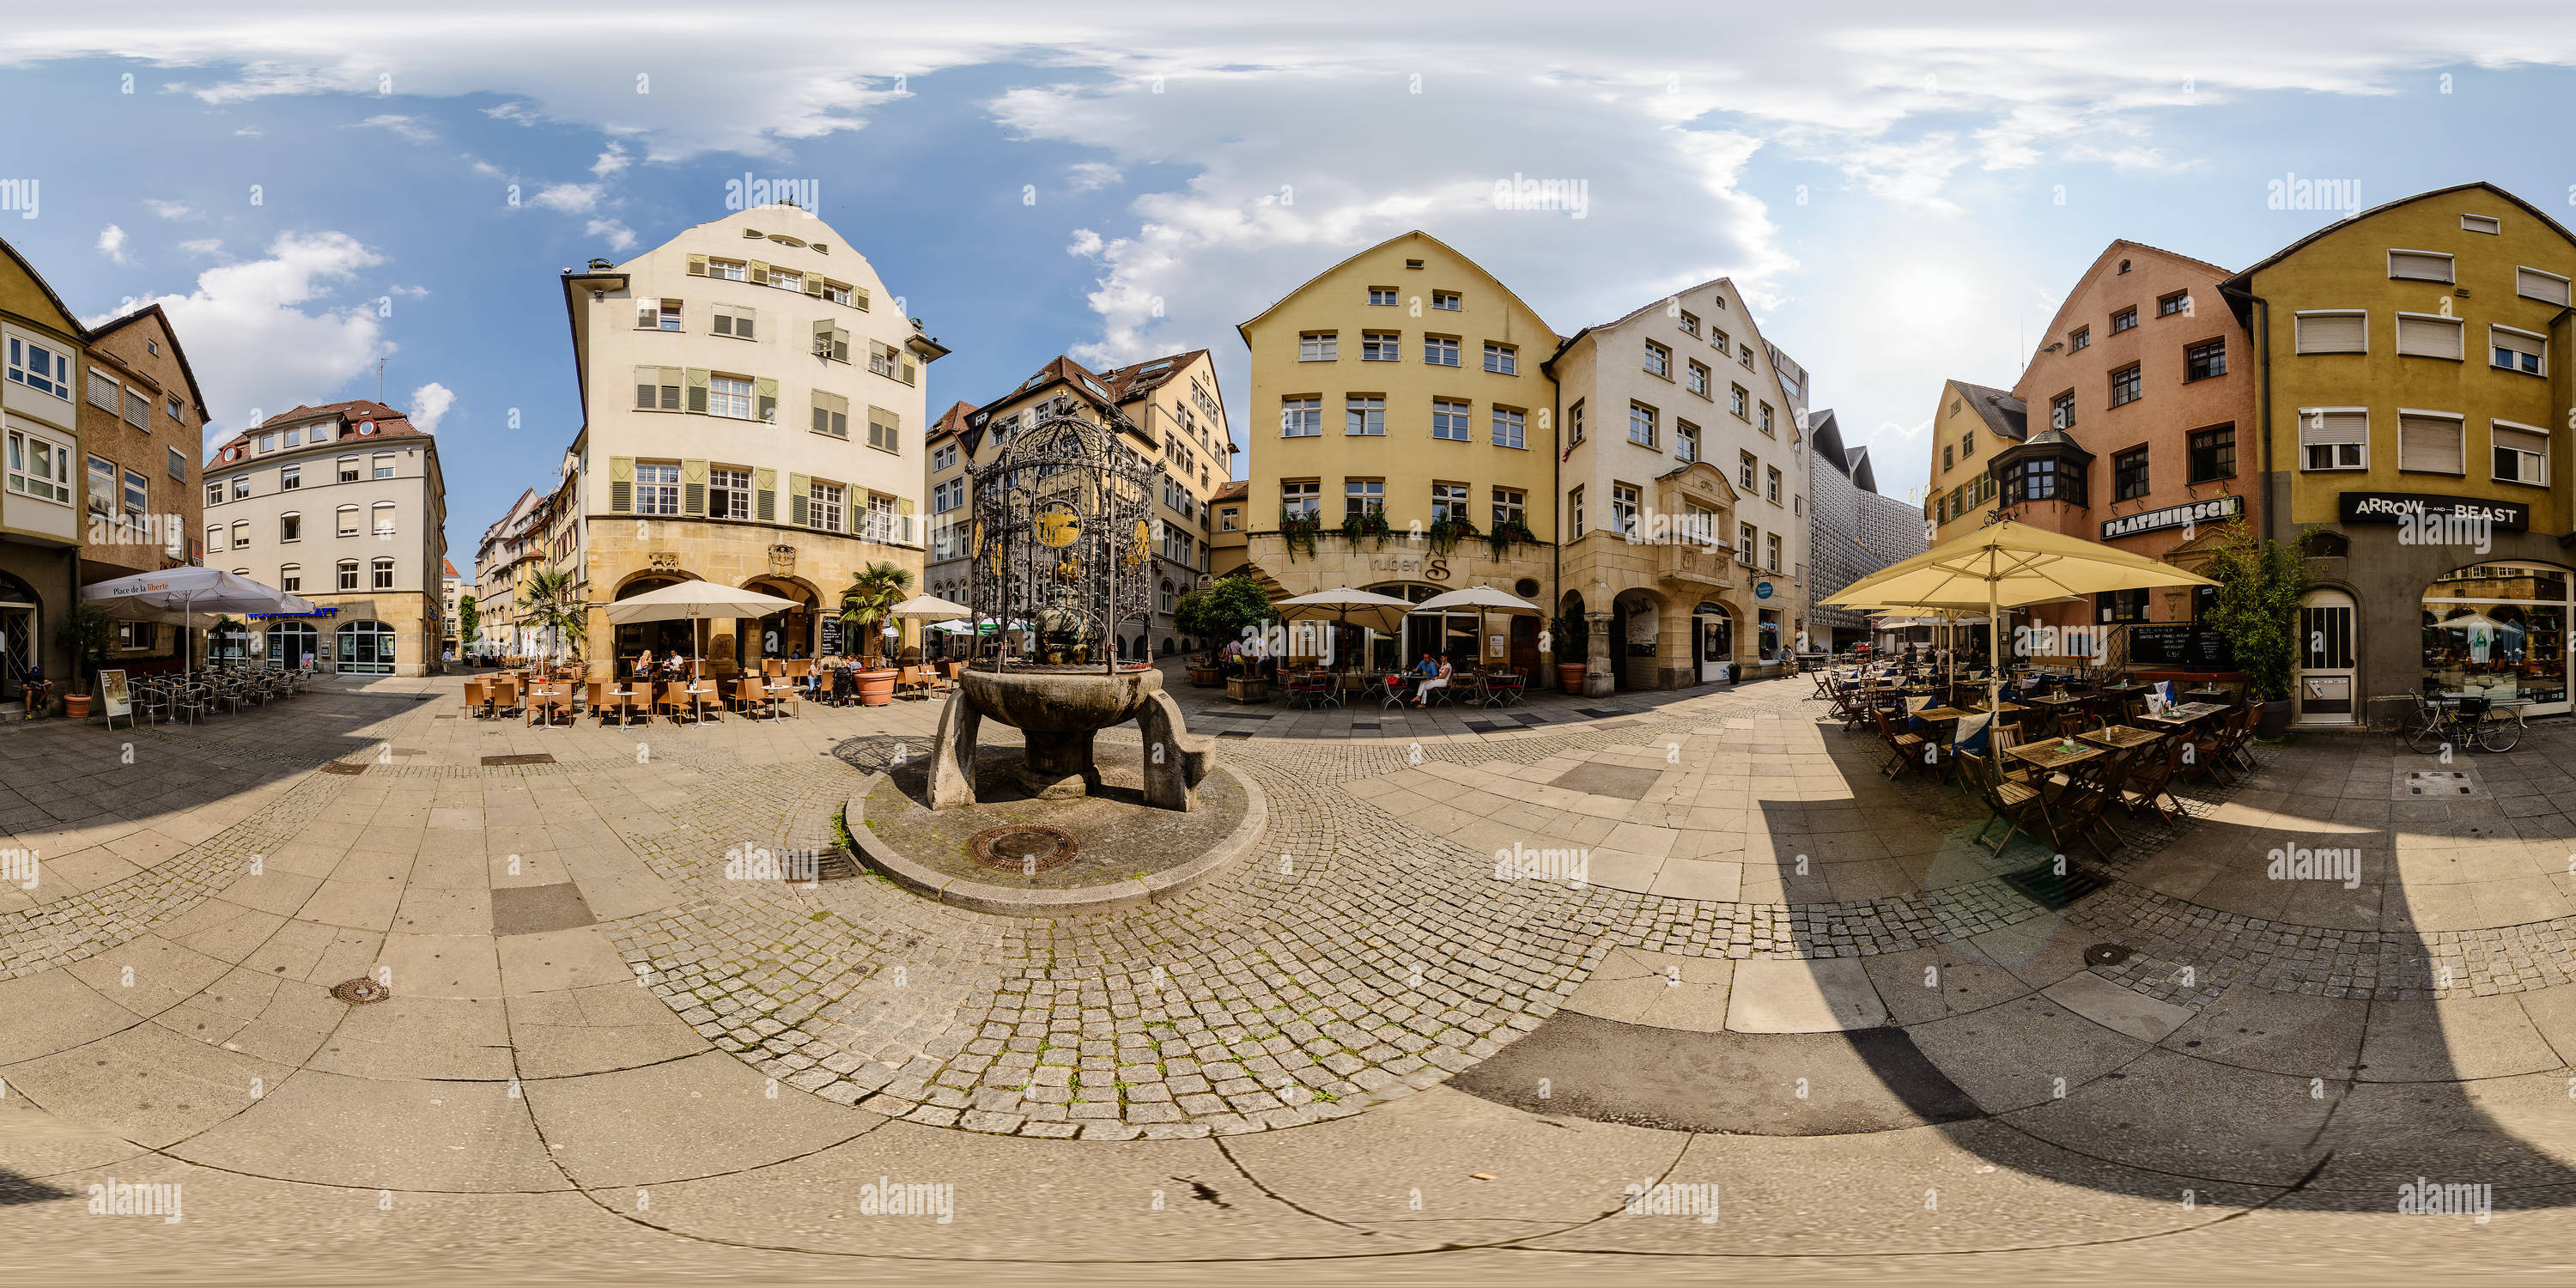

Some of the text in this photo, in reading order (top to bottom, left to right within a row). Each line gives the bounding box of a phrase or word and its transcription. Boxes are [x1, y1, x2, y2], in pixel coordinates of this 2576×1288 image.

[2105, 498, 2236, 537] PLATZHIRSCH
[2355, 497, 2424, 516] ARROW
[2455, 504, 2518, 523] BEAST
[1372, 556, 1422, 571] ruben
